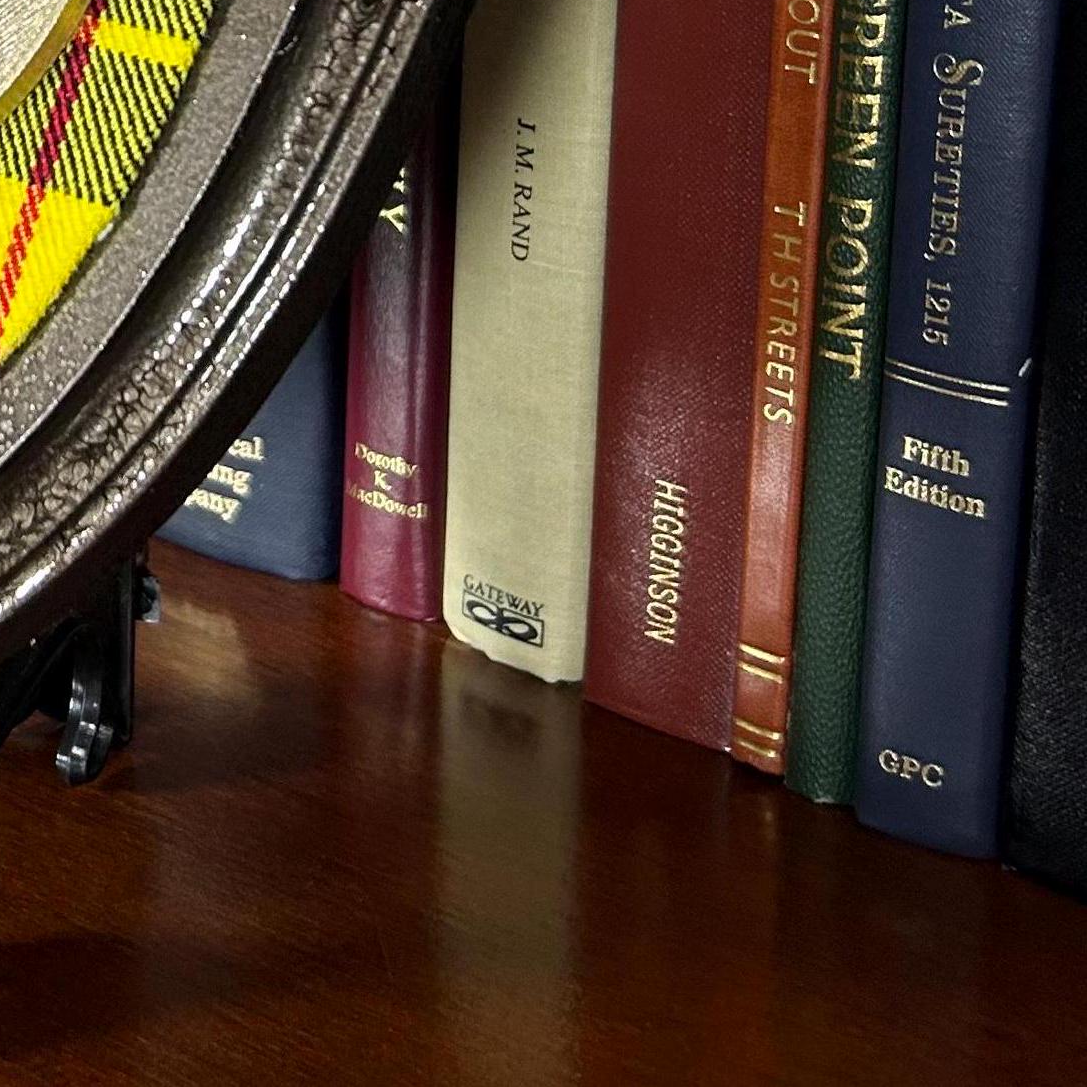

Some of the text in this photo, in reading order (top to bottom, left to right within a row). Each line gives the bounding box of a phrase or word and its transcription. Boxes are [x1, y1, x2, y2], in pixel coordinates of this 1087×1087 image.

[511, 117, 537, 262] J. M. RAND
[818, 196, 874, 382] POINT
[921, 281, 953, 348] 1215
[763, 271, 801, 426] STREETS
[354, 441, 418, 479] Dorothy
[901, 434, 971, 477] Fifth
[883, 464, 986, 519] Edition
[643, 479, 688, 645] HIGGINSON
[463, 573, 545, 617] GATEWAY
[877, 748, 946, 789] GPC
